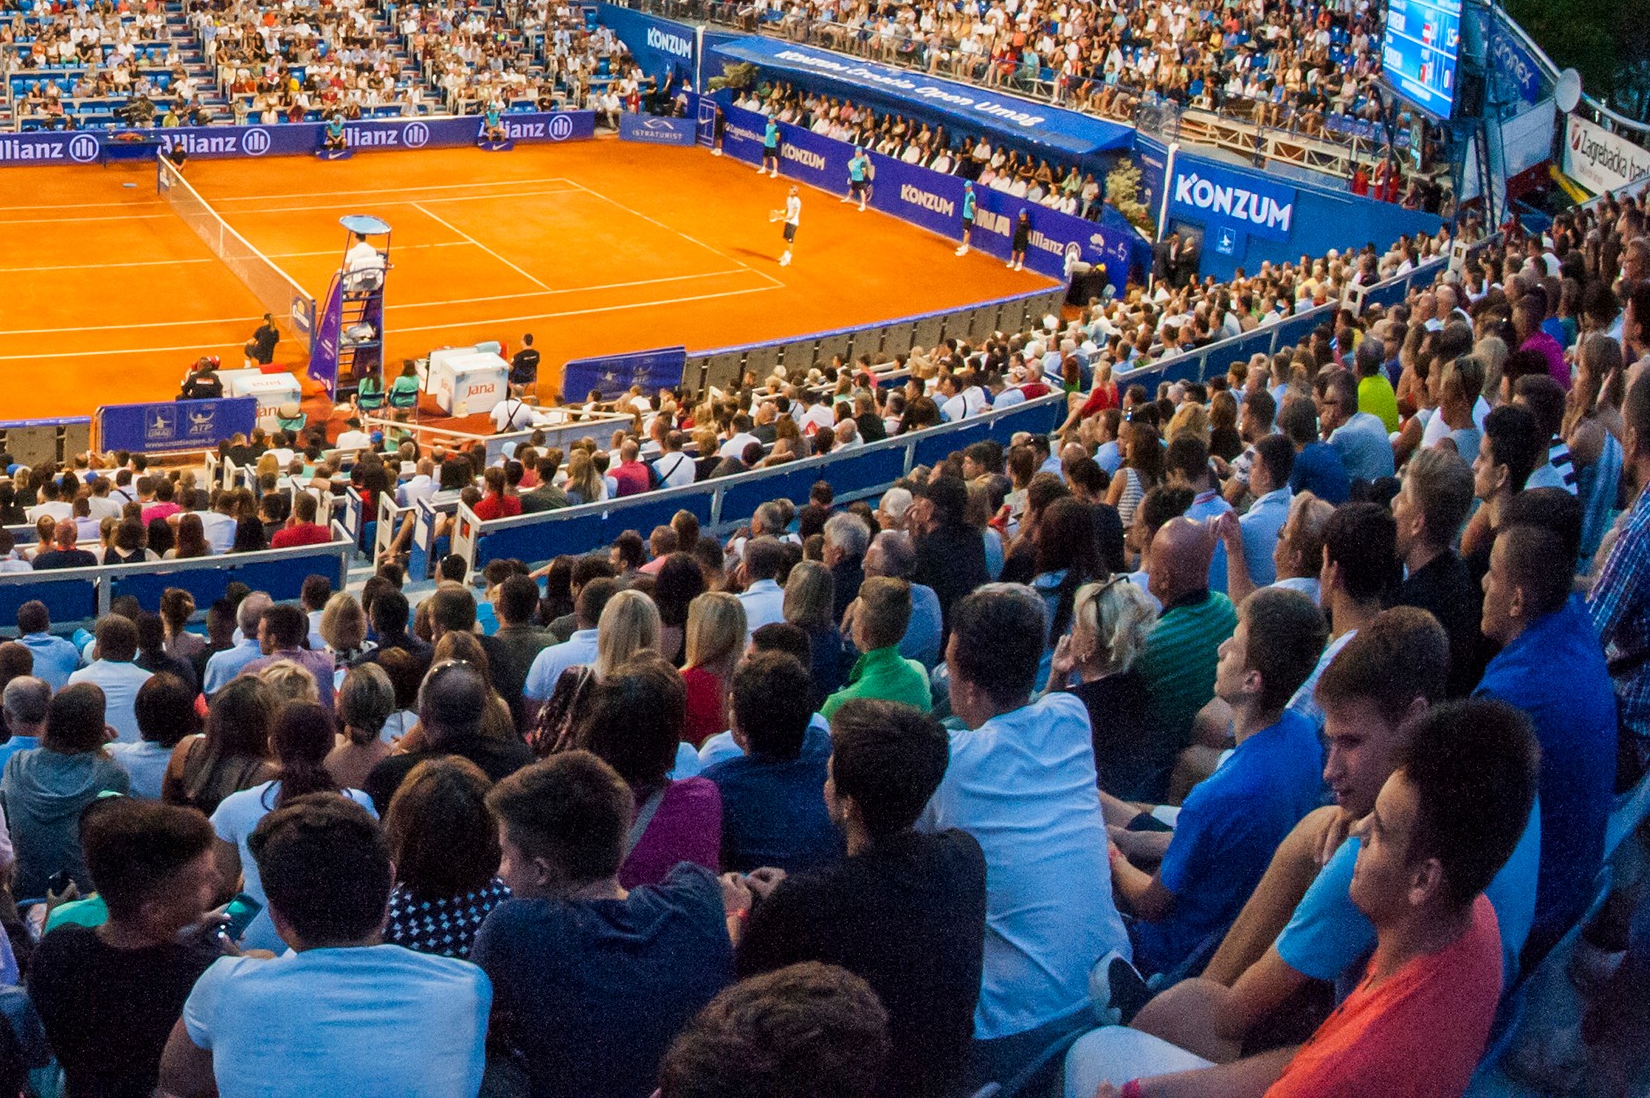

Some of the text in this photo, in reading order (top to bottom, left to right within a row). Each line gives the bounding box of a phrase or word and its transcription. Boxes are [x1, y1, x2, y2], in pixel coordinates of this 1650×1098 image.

[647, 27, 692, 59] KONZUM
[849, 67, 916, 89] Croatia
[914, 86, 975, 106] Open
[974, 101, 1045, 127] Umag
[632, 129, 683, 140] ISTRATURIST
[781, 143, 826, 171] KONZUM
[900, 183, 955, 217] KONZUM
[1175, 172, 1293, 232] KONZUM
[467, 383, 495, 397] Jana
[189, 424, 215, 435] ATP
